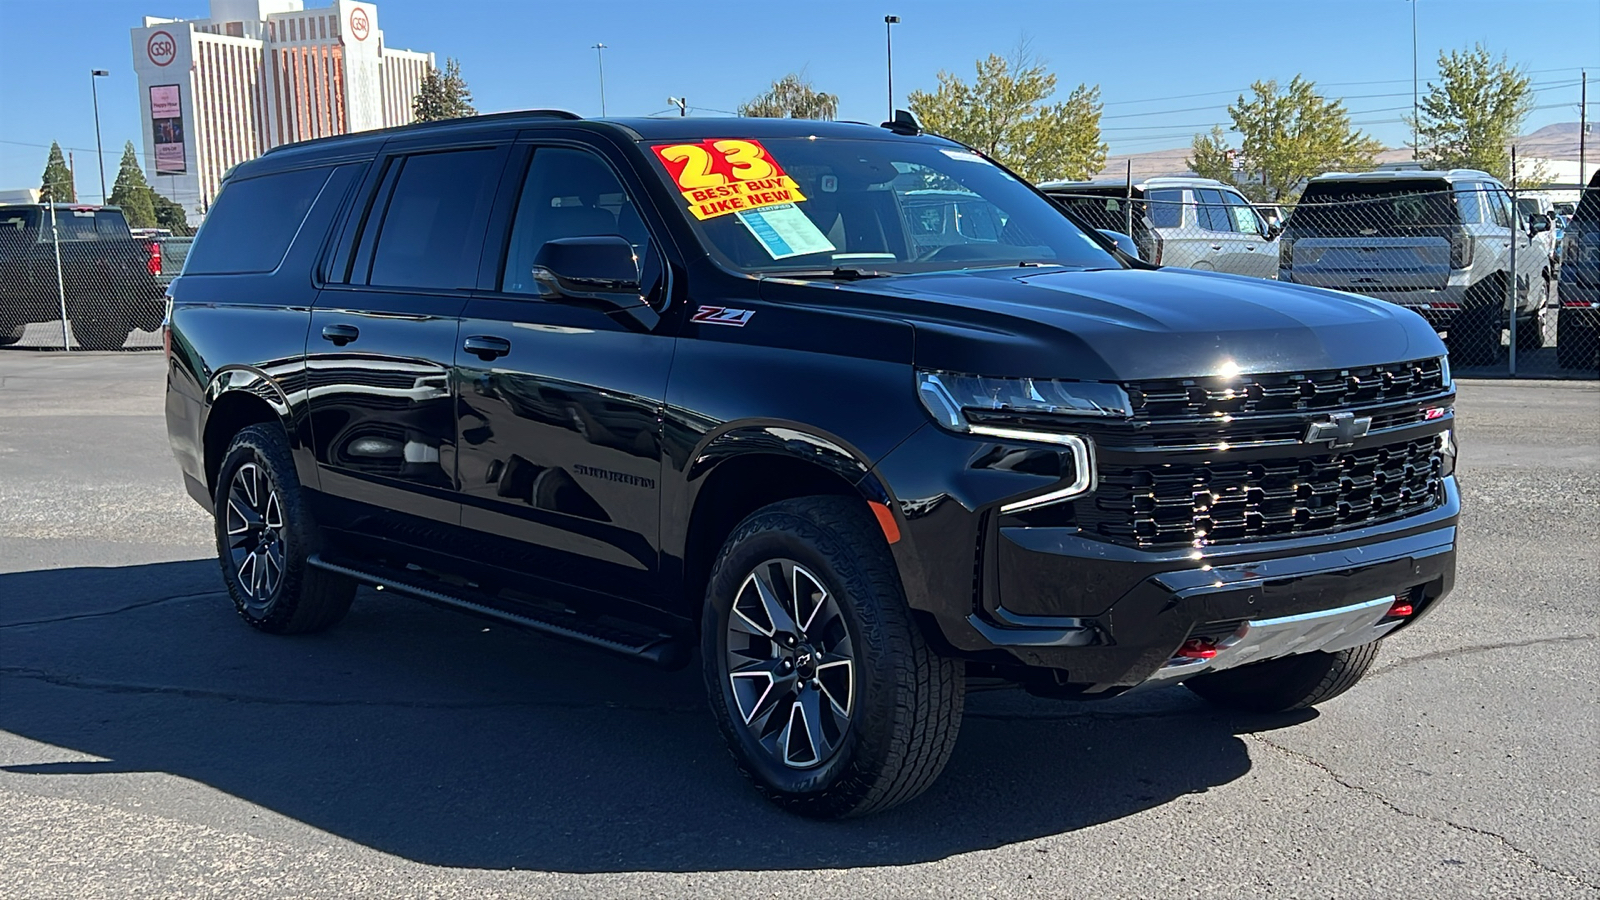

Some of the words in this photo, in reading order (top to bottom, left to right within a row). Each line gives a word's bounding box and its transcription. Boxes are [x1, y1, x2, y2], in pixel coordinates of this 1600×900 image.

[353, 17, 368, 33] GSR
[150, 41, 173, 57] GSR
[660, 139, 777, 189] 23
[692, 183, 741, 202] BEST
[744, 177, 785, 193] BUY
[700, 197, 745, 216] LIKE
[747, 189, 792, 205] NEW
[690, 305, 756, 327] Z71
[573, 463, 656, 489] SUBURBAN
